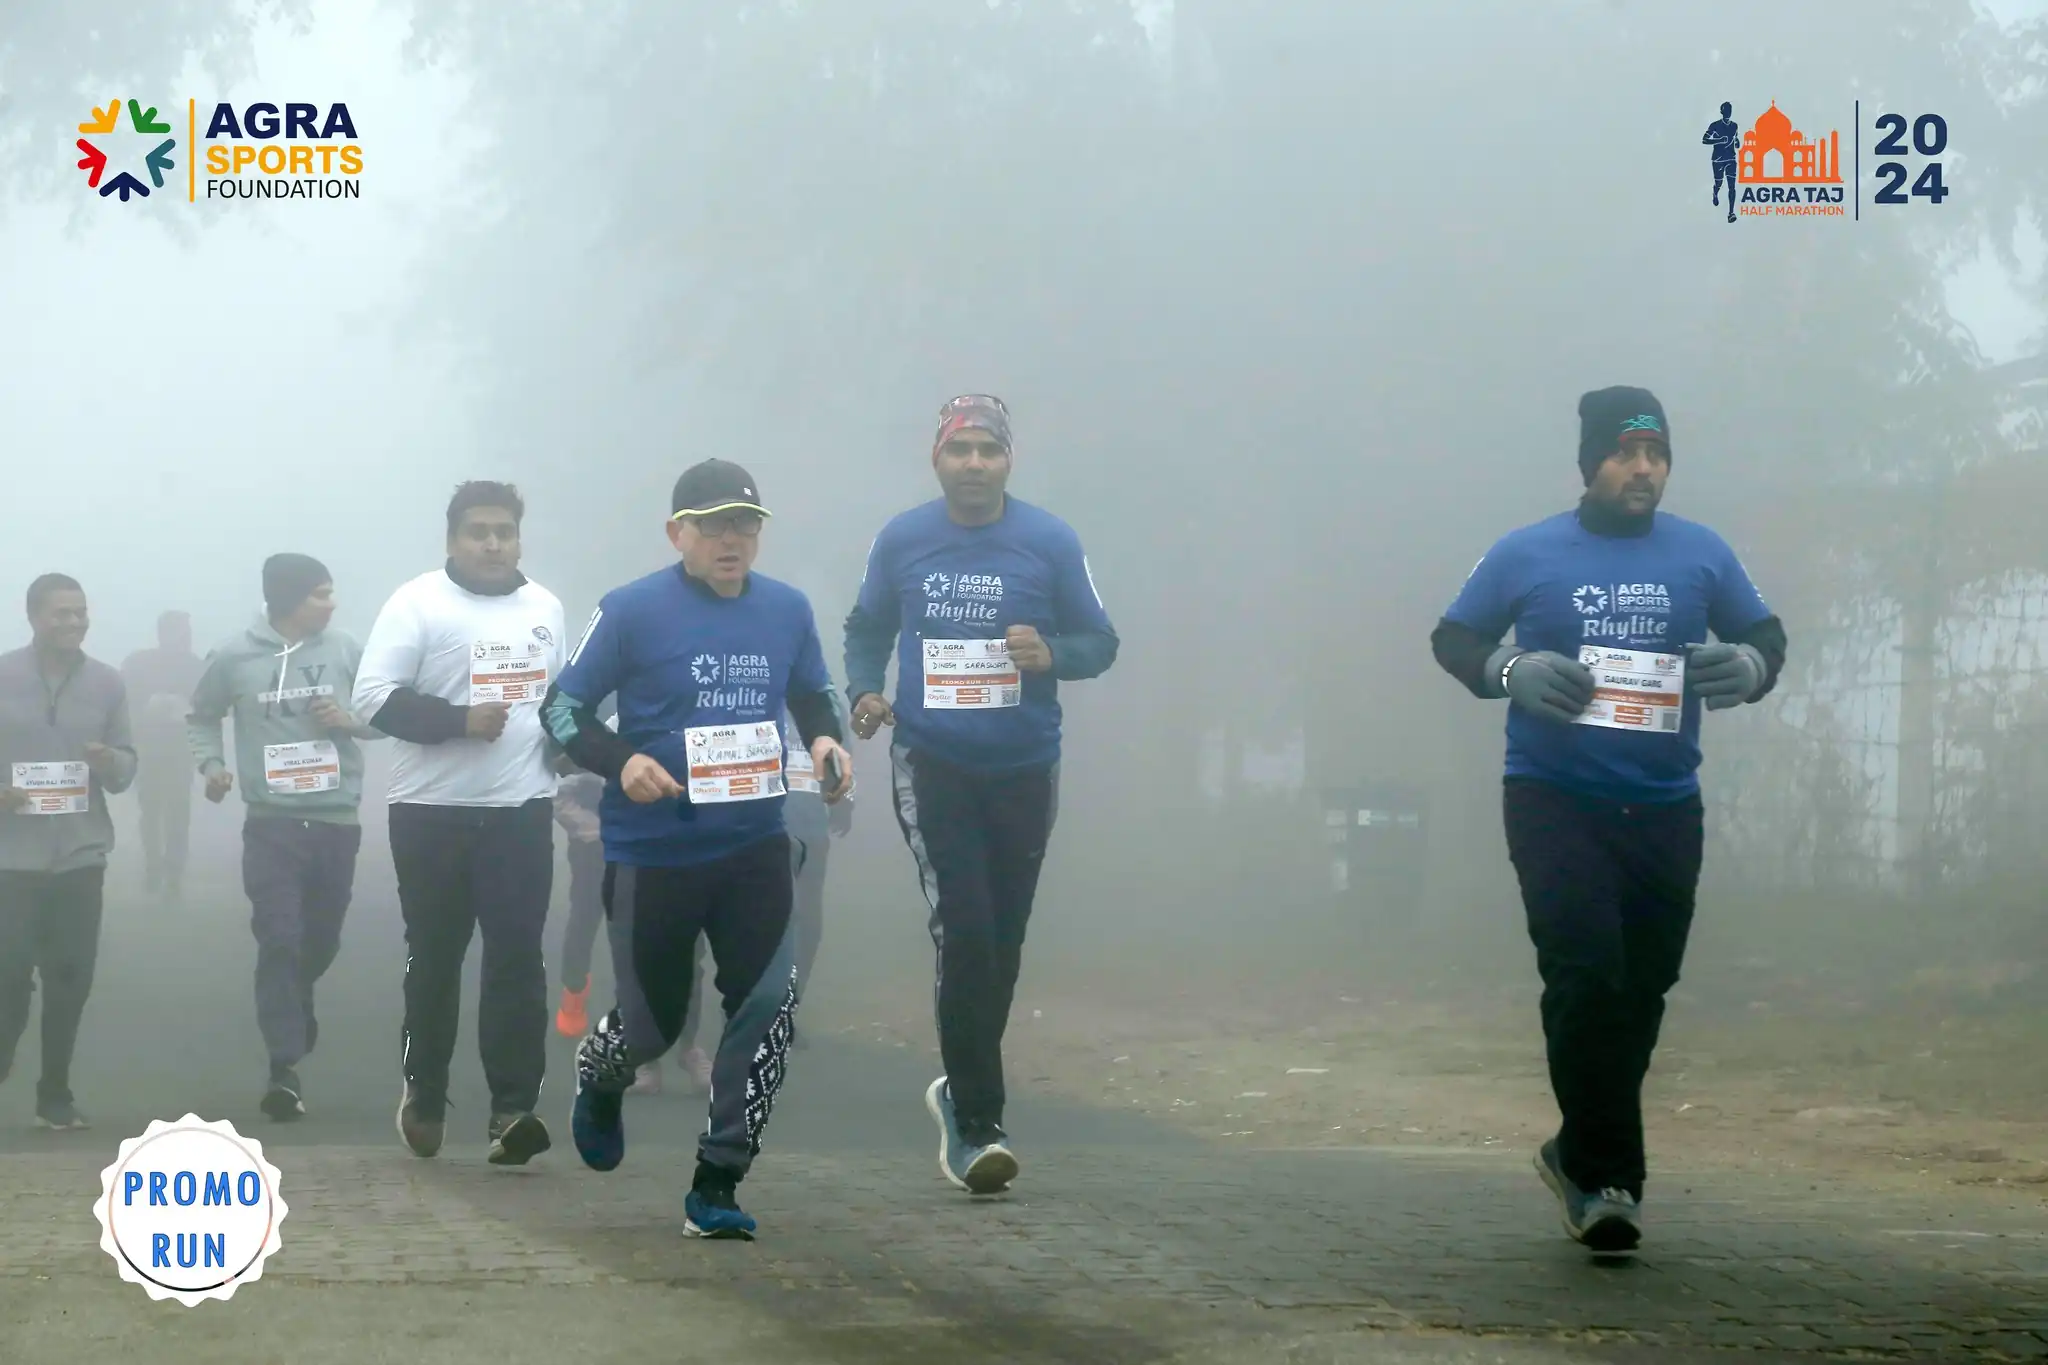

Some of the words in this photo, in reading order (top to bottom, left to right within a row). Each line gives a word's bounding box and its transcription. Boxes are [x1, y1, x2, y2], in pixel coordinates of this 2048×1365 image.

[959, 574, 1003, 586] AGRA
[957, 584, 1004, 595] SPORTS
[1618, 583, 1669, 596] AGRA
[957, 593, 1002, 601] FOUNDATION
[1618, 596, 1672, 607] SPORTS
[924, 601, 998, 622] Rhylite
[1583, 615, 1668, 640] Rhylite
[496, 662, 509, 670] JAY
[728, 654, 769, 667] AGRA
[728, 667, 770, 678] SPORTS
[695, 686, 767, 711] Rhylite
[712, 729, 737, 738] AGRA
